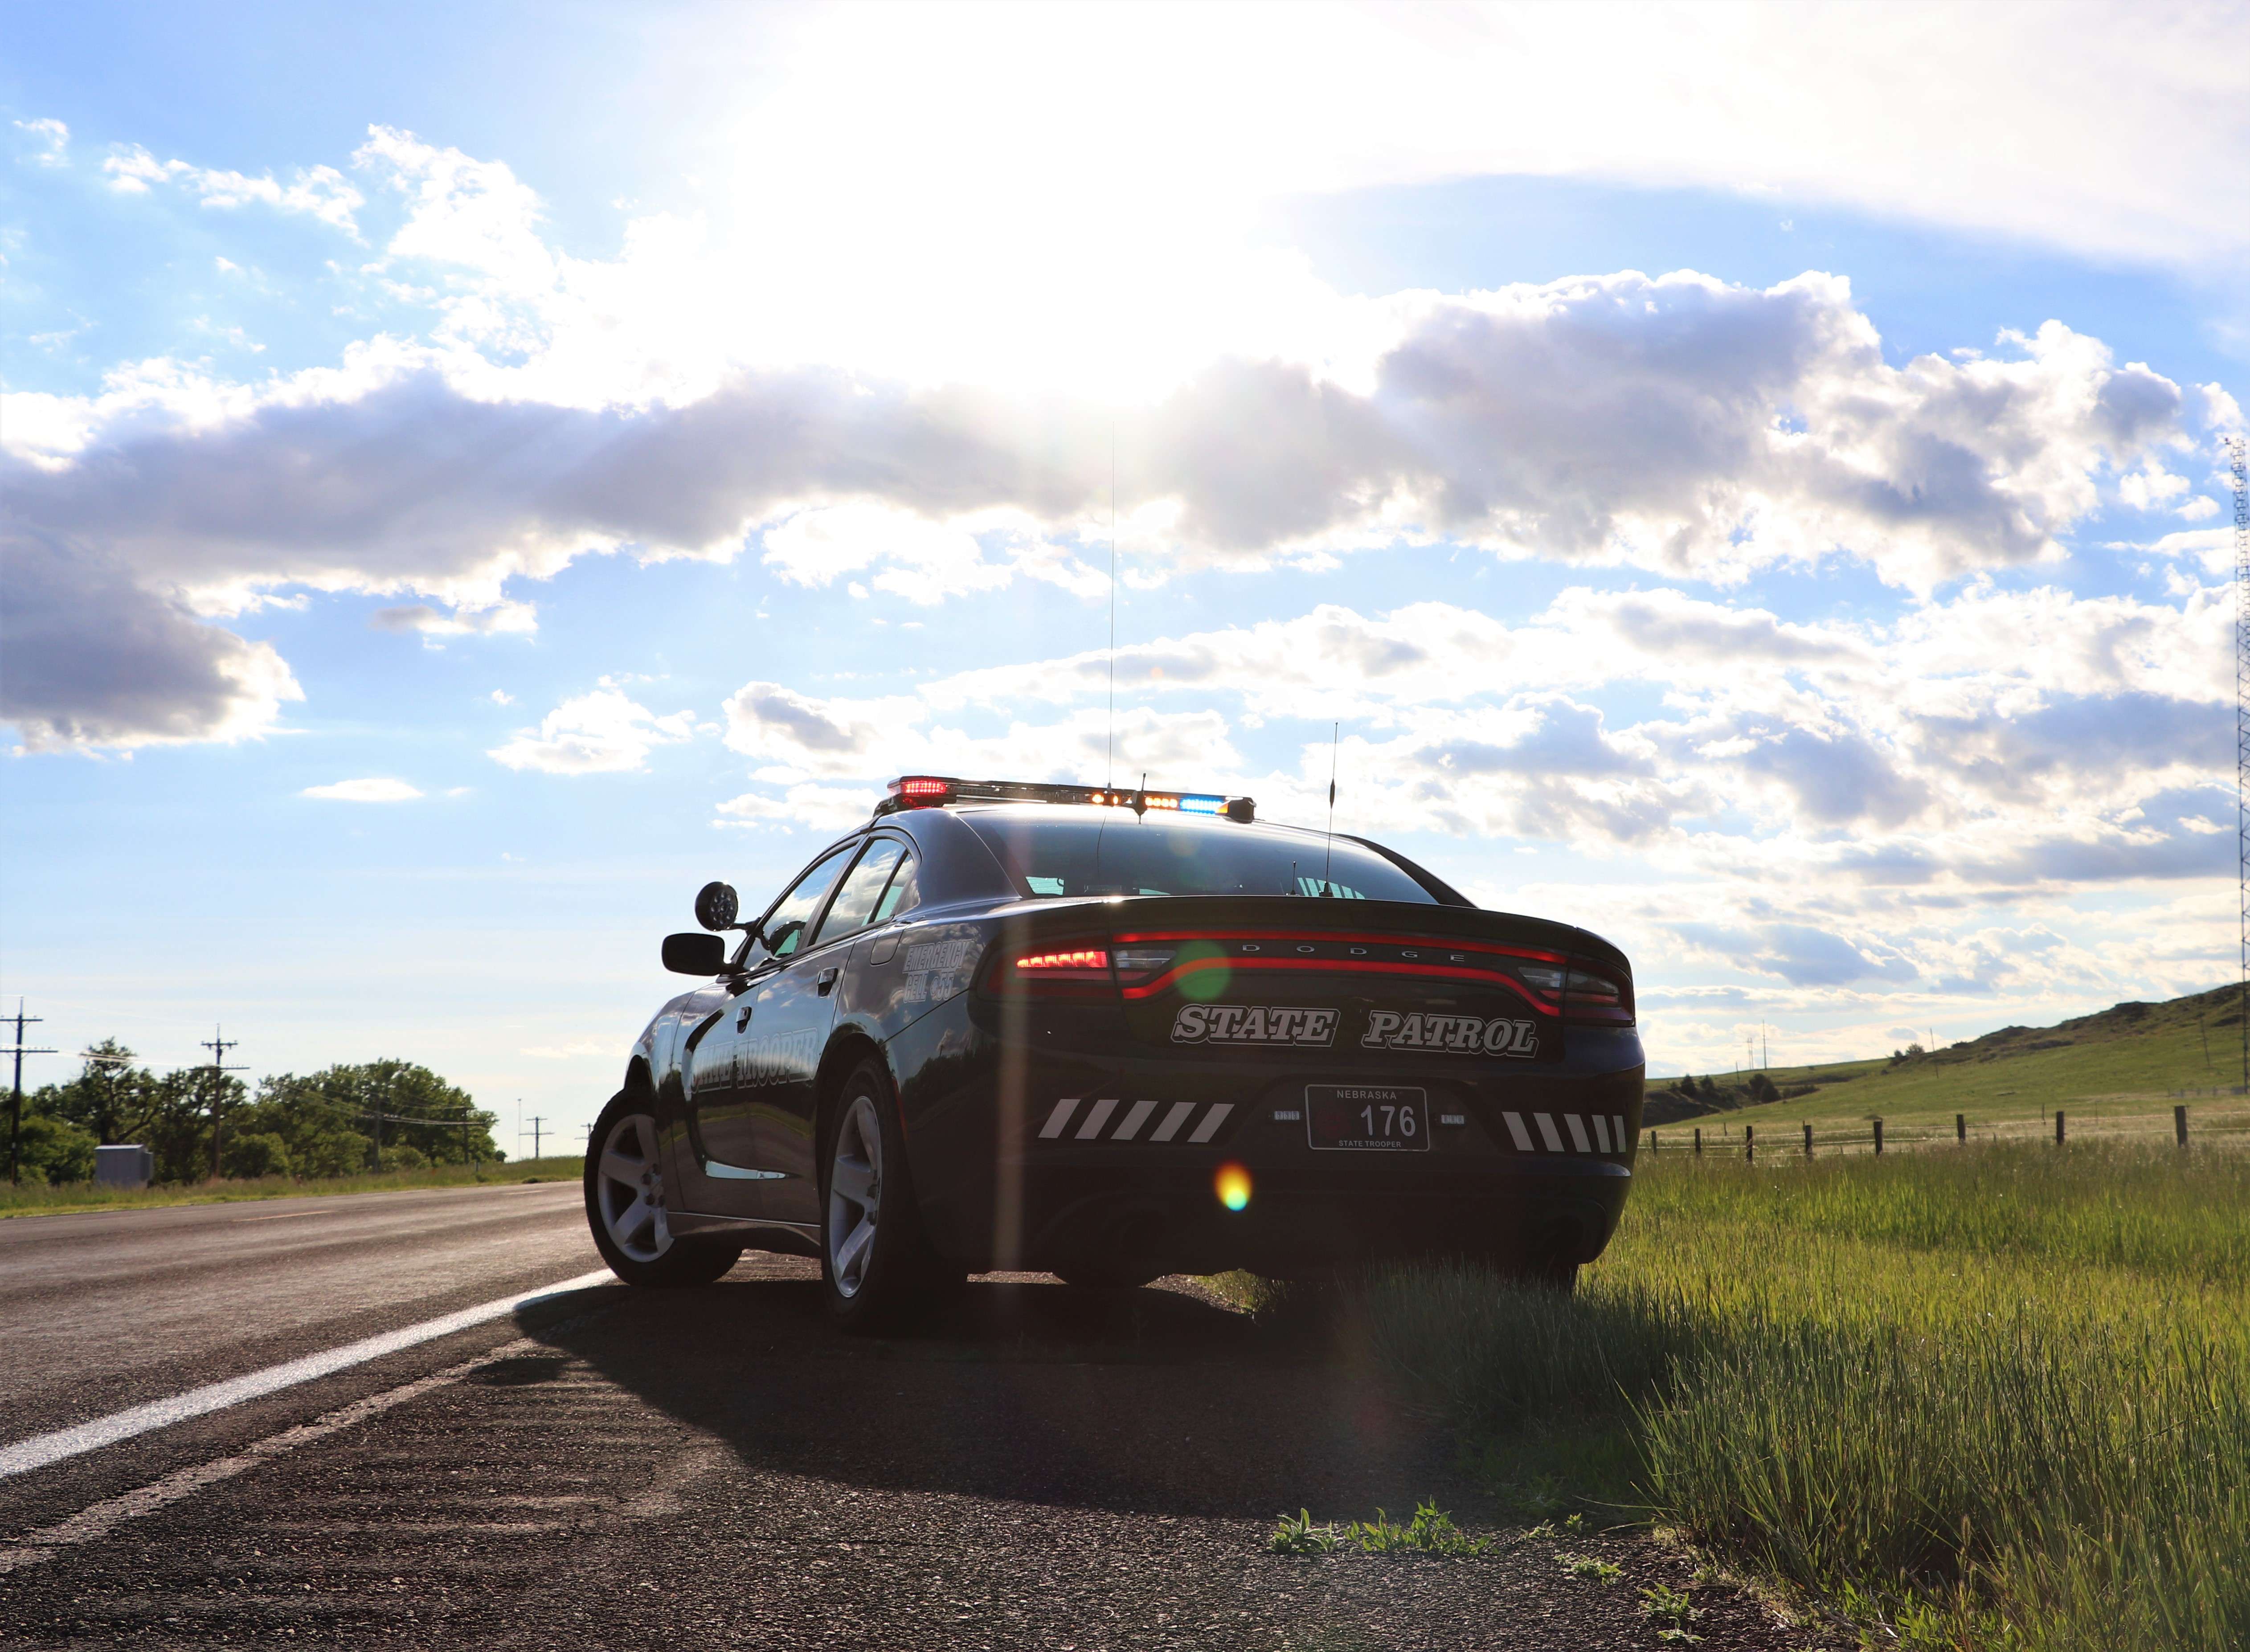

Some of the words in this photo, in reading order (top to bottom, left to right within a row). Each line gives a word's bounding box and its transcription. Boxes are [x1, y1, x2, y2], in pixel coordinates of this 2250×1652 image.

[903, 939, 973, 973] EMERGENCY
[1242, 945, 1465, 962] DODGE
[903, 973, 928, 1003] CELL
[1170, 1003, 1341, 1047] STATE
[1361, 1010, 1539, 1058] PATROL
[736, 1027, 818, 1089] TROOPER
[1337, 1090, 1397, 1100] NEBRASKA
[1360, 1104, 1416, 1137] 176
